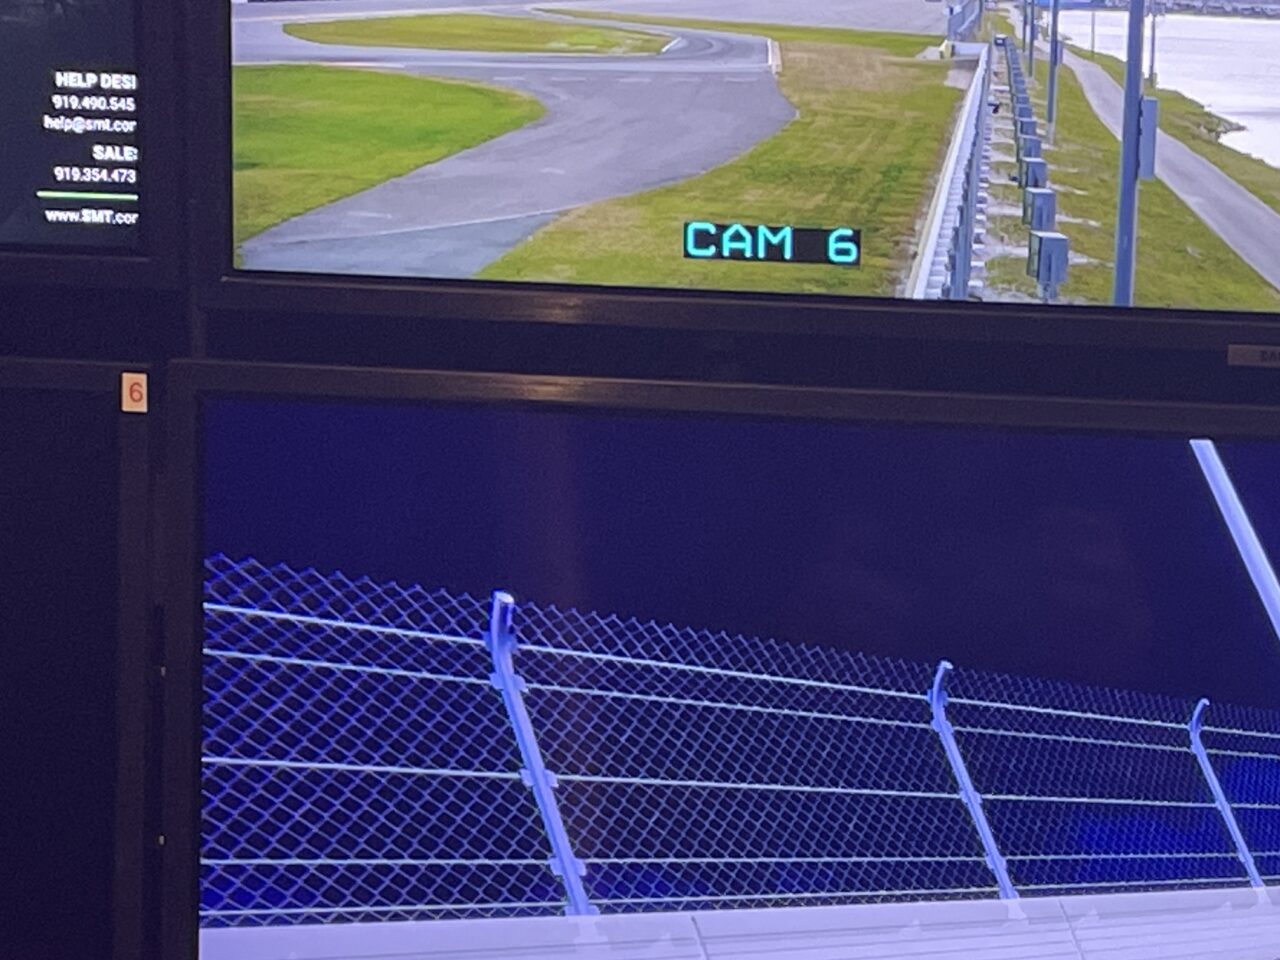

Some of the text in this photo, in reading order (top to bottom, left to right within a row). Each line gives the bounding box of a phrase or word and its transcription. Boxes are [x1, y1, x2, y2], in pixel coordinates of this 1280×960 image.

[55, 71, 98, 88] HELP
[686, 221, 858, 263] CAM 6
[129, 381, 144, 403] 6
